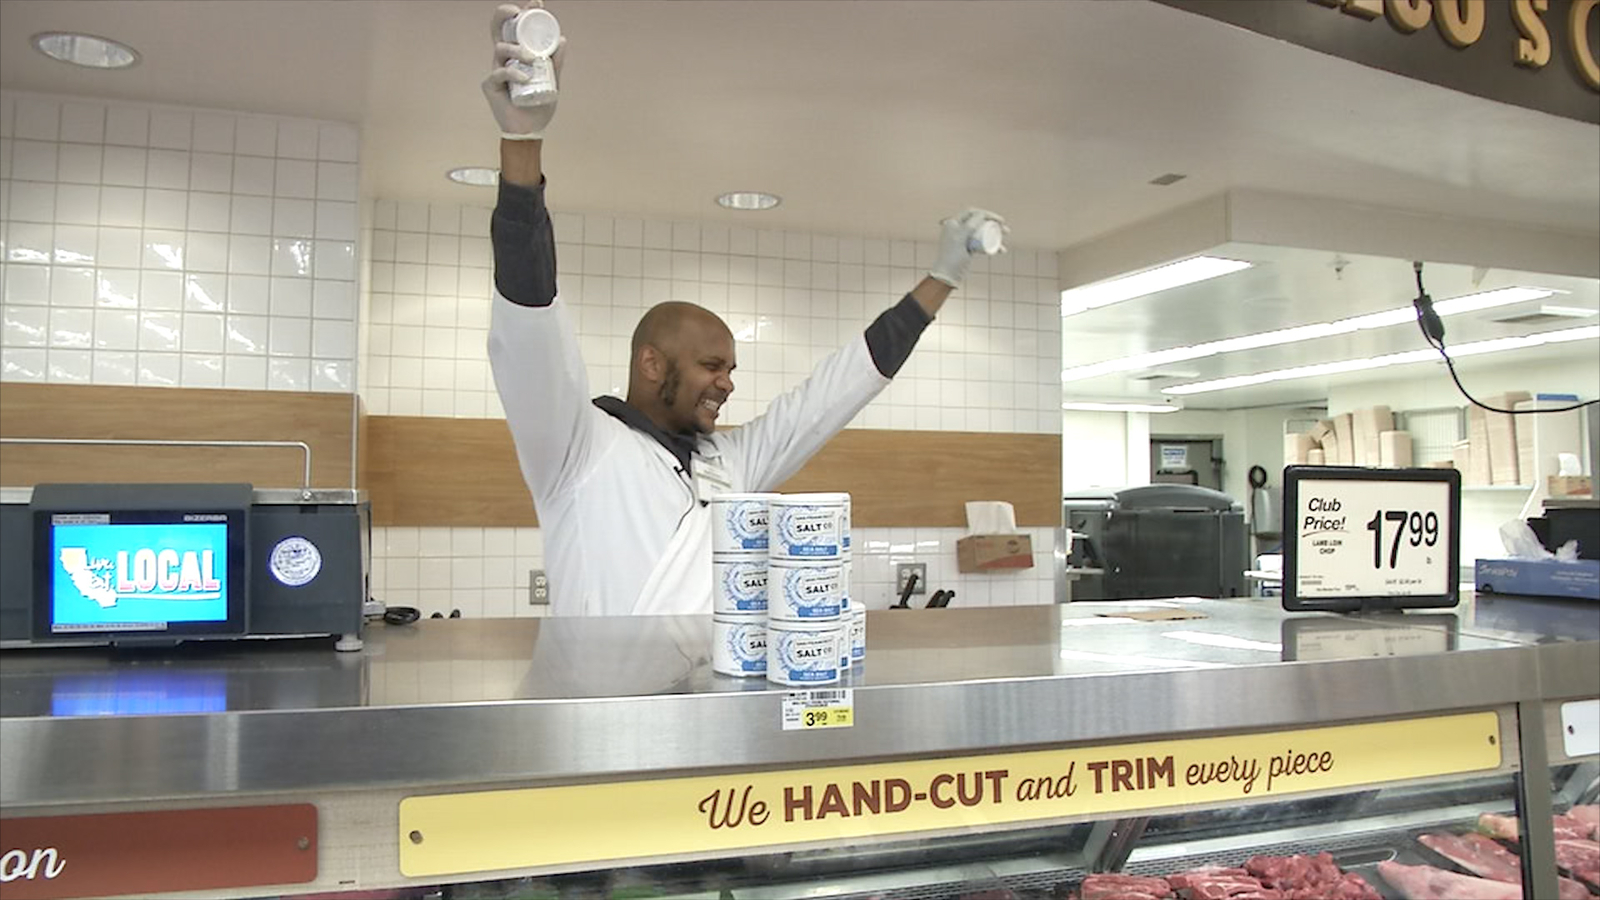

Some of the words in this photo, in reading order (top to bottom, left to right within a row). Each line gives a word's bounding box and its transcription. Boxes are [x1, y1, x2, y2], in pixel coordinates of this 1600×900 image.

[1308, 498, 1341, 512] Club
[749, 518, 769, 527] SAL
[1304, 516, 1346, 530] Price!
[796, 523, 822, 533] SALT
[117, 549, 221, 592] LOCAL
[805, 585, 829, 594] SALT
[749, 641, 767, 649] SAL
[796, 648, 822, 658] SALT
[699, 785, 770, 829] We
[783, 769, 1009, 822] HAND-CUT
[1016, 761, 1077, 801] and
[1087, 755, 1175, 794] TRIM
[1186, 755, 1260, 794] every
[1266, 749, 1334, 791] piece
